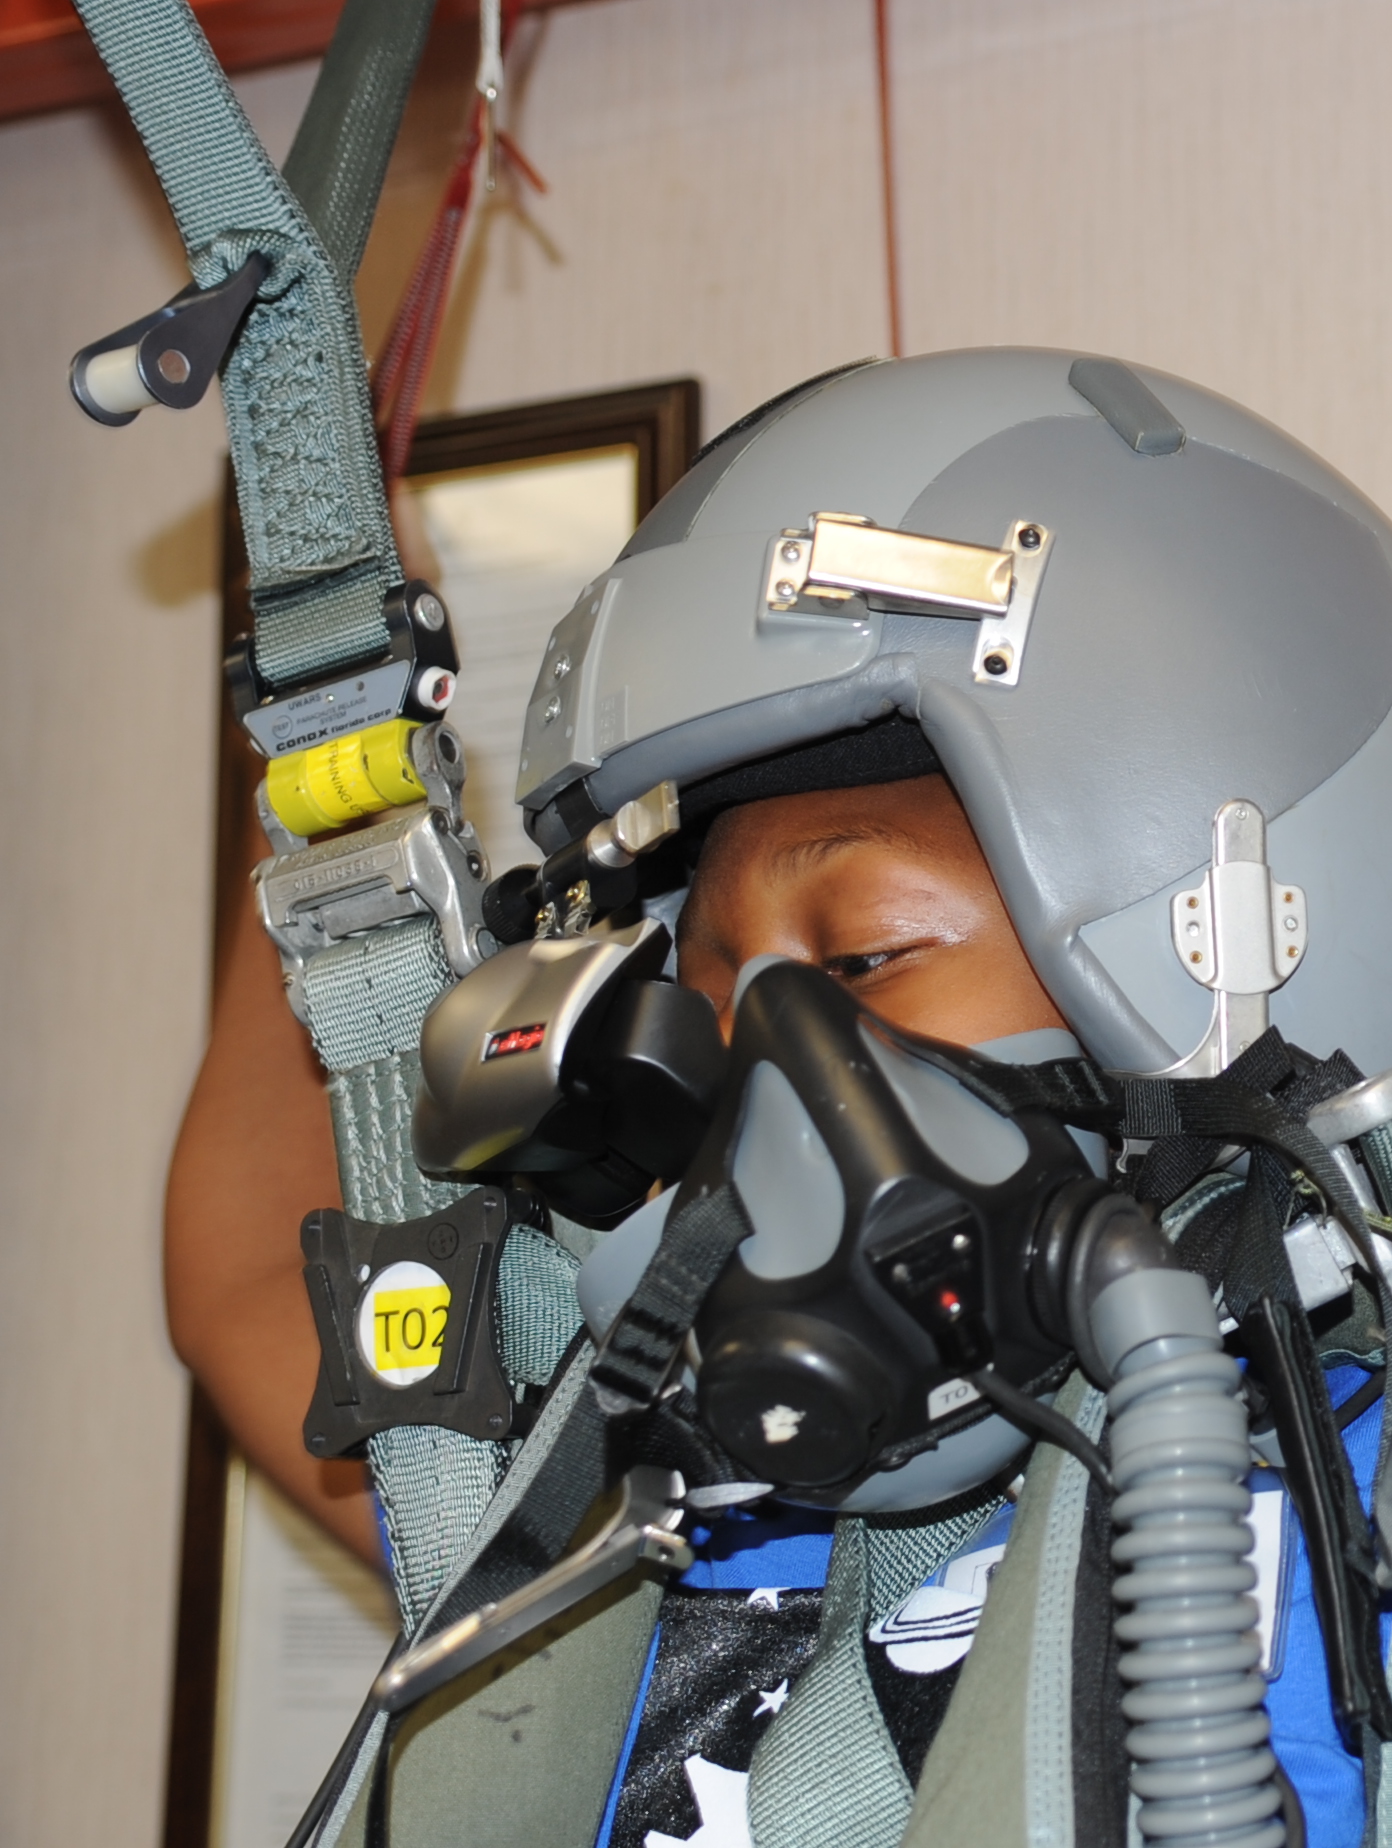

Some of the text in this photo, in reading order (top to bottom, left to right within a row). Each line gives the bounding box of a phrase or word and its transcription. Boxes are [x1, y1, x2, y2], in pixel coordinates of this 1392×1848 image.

[288, 692, 321, 711] UWARS
[296, 696, 367, 725] PARACHUTE RELEASE
[320, 710, 347, 725] SYSTEM
[368, 708, 392, 721] corp
[328, 741, 353, 804] TRAINING
[374, 1304, 449, 1353] T02
